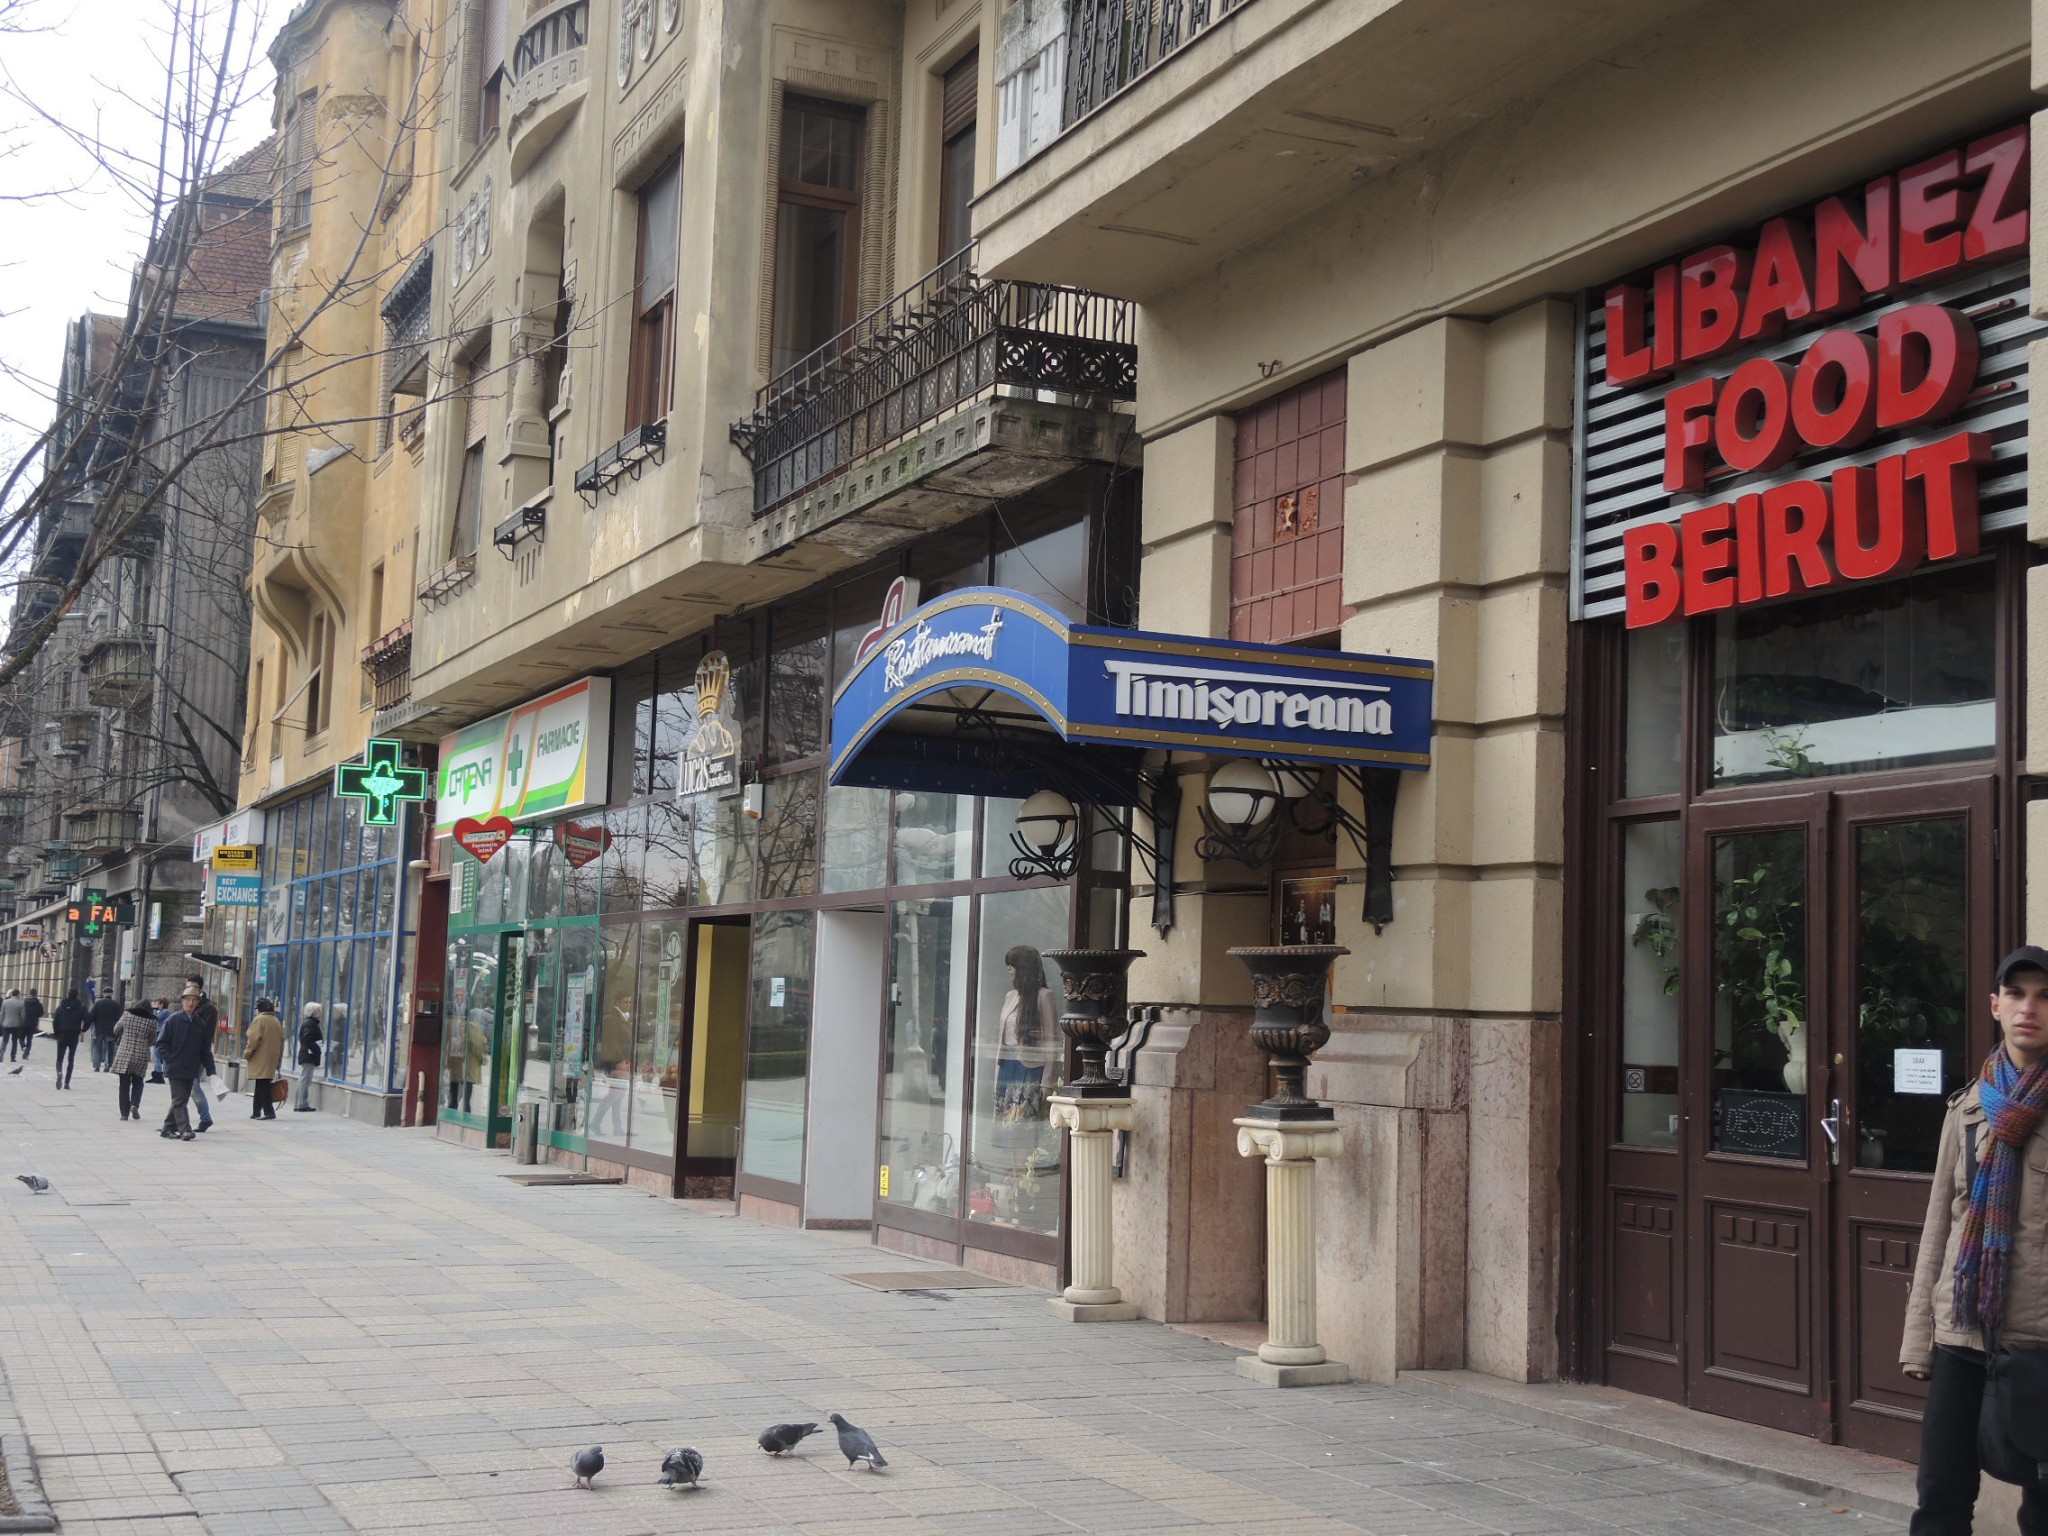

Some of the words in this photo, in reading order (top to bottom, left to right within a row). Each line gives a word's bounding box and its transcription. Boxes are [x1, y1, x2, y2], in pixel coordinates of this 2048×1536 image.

[1605, 123, 2030, 388] LIBANEZ
[1663, 302, 1979, 494] FOOD
[1622, 430, 1993, 629] BEIRUT
[537, 720, 580, 757] FARMACIE
[678, 750, 709, 795] Lucas
[217, 886, 259, 903] EXCHANGE
[222, 878, 236, 886] BEST
[23, 927, 37, 935] dm
[68, 908, 80, 920] a
